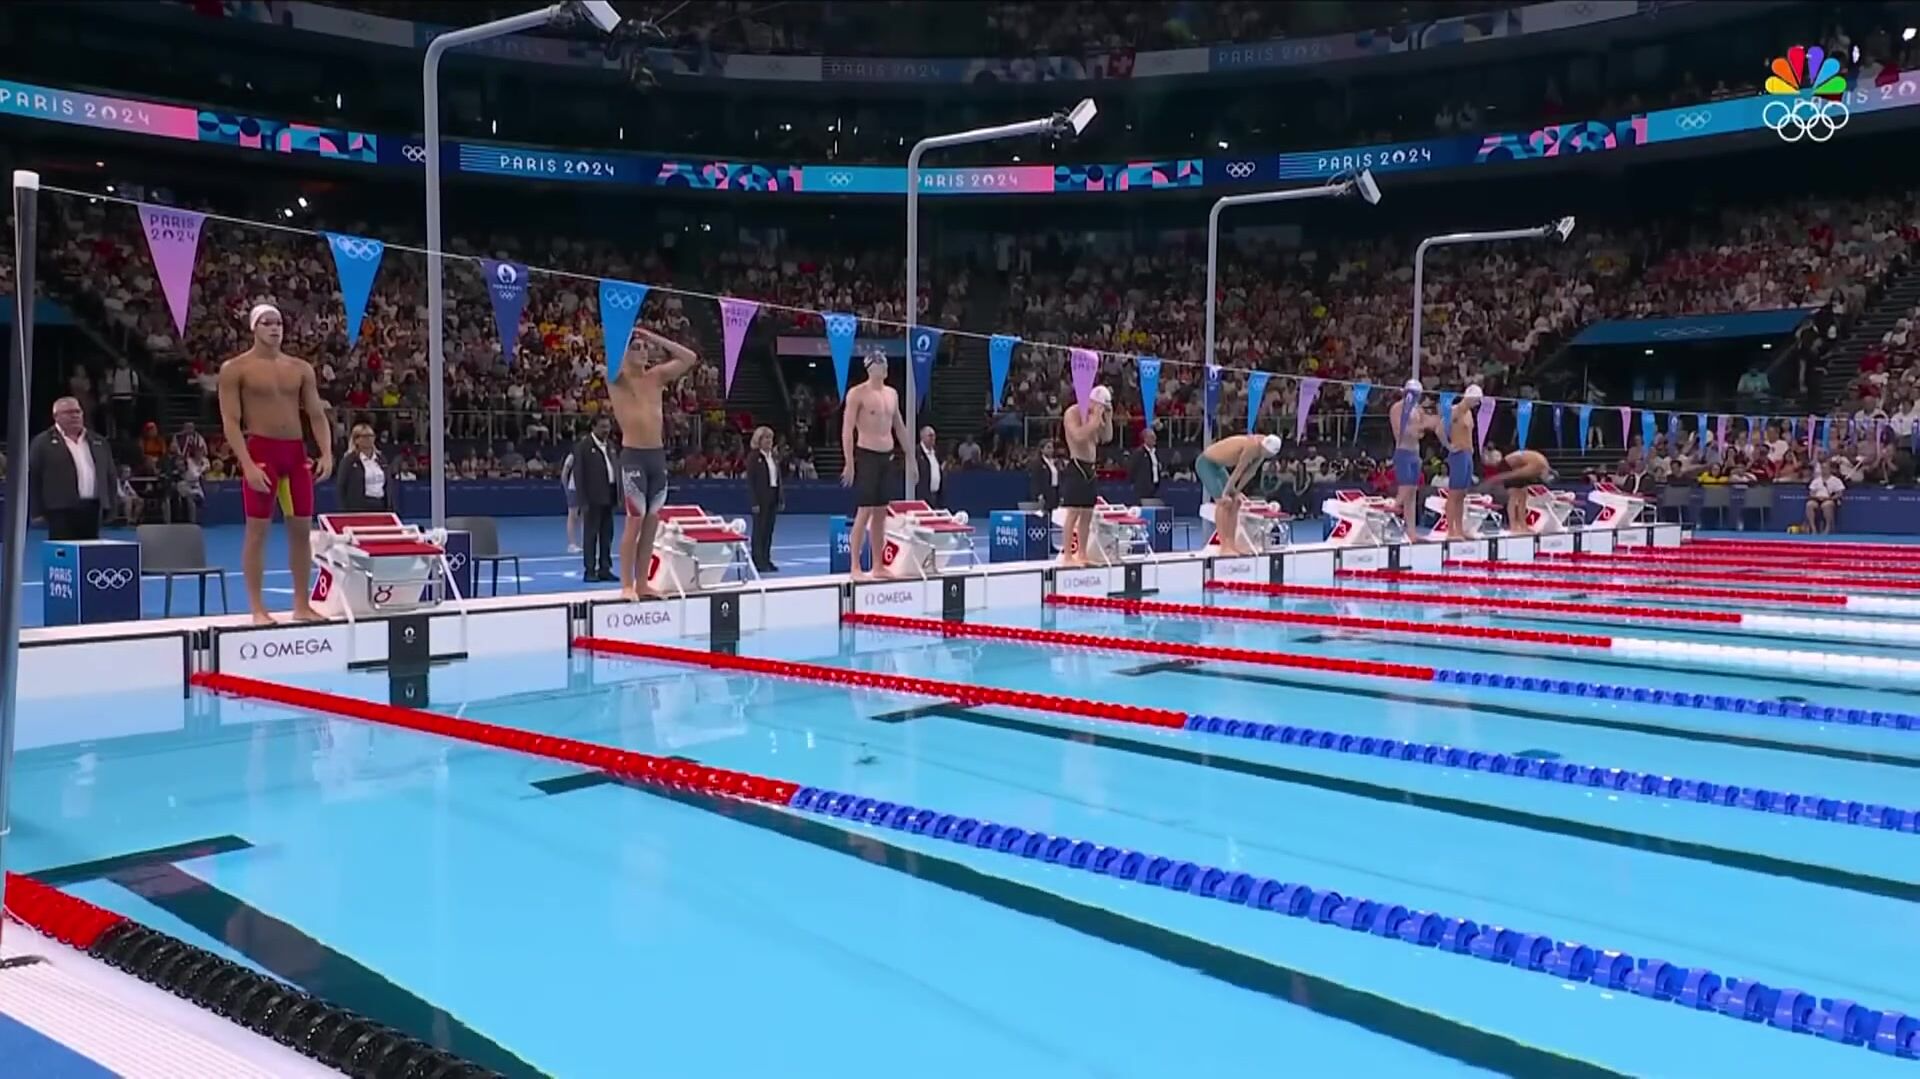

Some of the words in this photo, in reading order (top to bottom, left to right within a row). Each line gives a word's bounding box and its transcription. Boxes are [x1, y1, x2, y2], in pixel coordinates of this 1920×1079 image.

[0, 87, 73, 115] PARIS
[85, 102, 150, 125] 2024
[500, 155, 556, 173] PARIS
[564, 160, 615, 177] 2024
[1318, 153, 1373, 171] PARIS
[1380, 147, 1432, 165] 2024
[971, 173, 1019, 188] 2024
[150, 213, 195, 229] PARIS
[151, 227, 195, 243] 2024
[995, 526, 1019, 537] PARIS
[1339, 523, 1347, 536] 3
[996, 536, 1019, 547] 2024
[884, 546, 893, 562] 6
[49, 566, 73, 583] PARIS
[50, 582, 73, 599] 2024
[319, 575, 327, 597] 8
[877, 591, 913, 605] OMEGA
[623, 611, 671, 627] OMEGA
[263, 638, 333, 658] OMEGA
